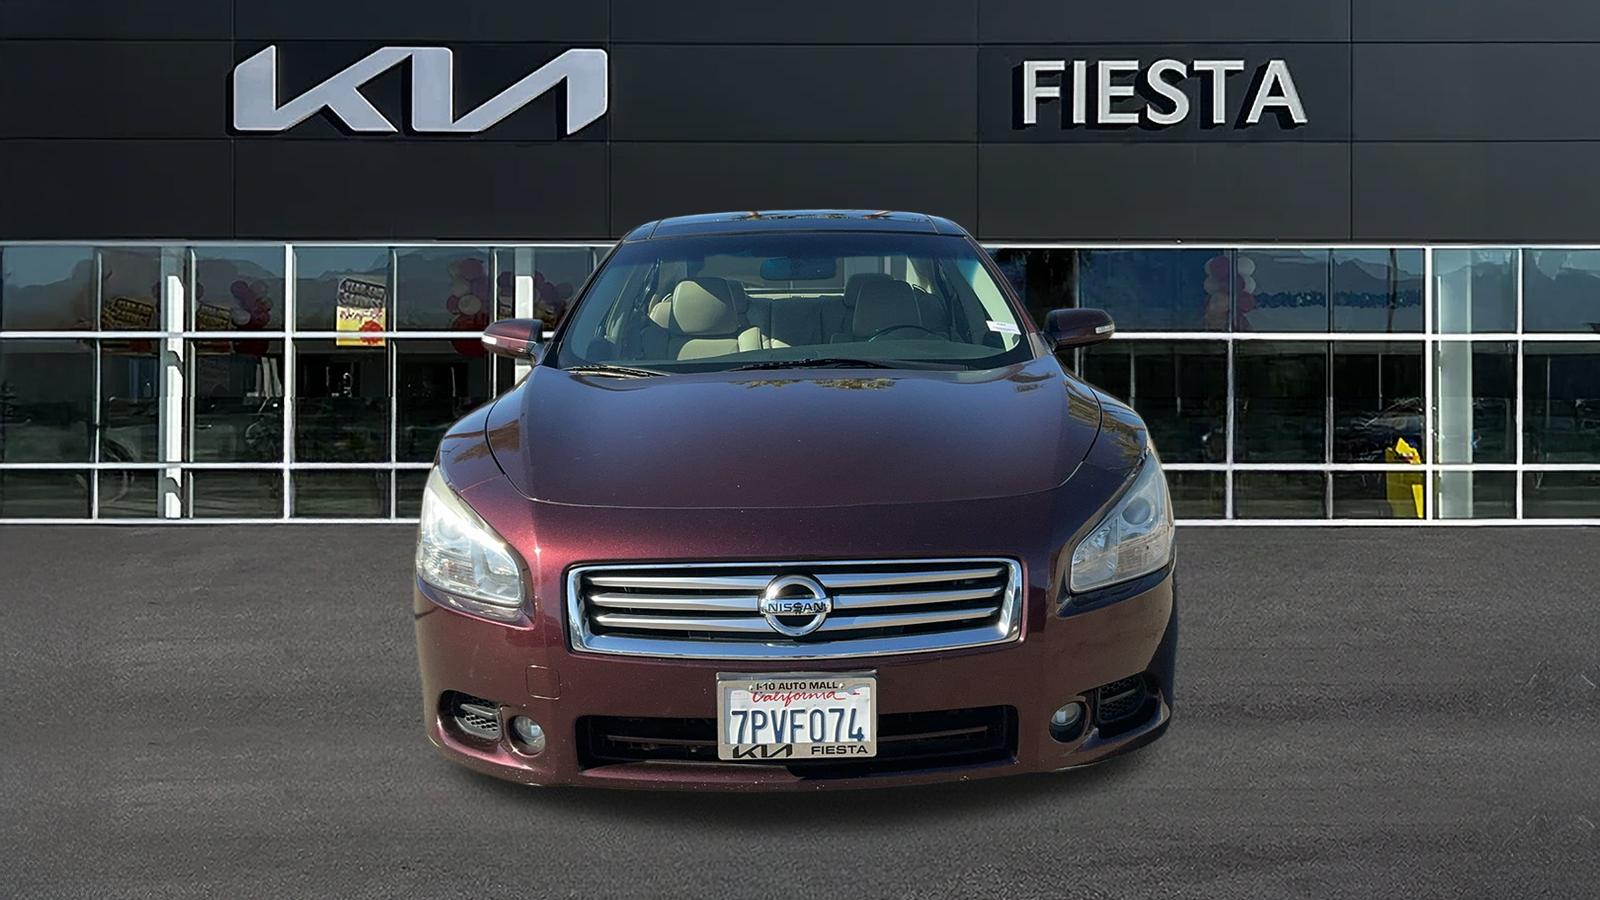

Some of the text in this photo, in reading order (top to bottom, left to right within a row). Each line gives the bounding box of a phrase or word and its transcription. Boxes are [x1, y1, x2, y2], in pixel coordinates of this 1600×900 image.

[233, 44, 609, 136] KIA
[1022, 58, 1309, 125] FIESTA
[767, 602, 824, 613] NISSAN
[756, 681, 838, 691] I-10 AUTO MALL
[752, 690, 846, 708] California
[731, 708, 865, 744] 7PVF074
[811, 745, 869, 755] FIESTA
